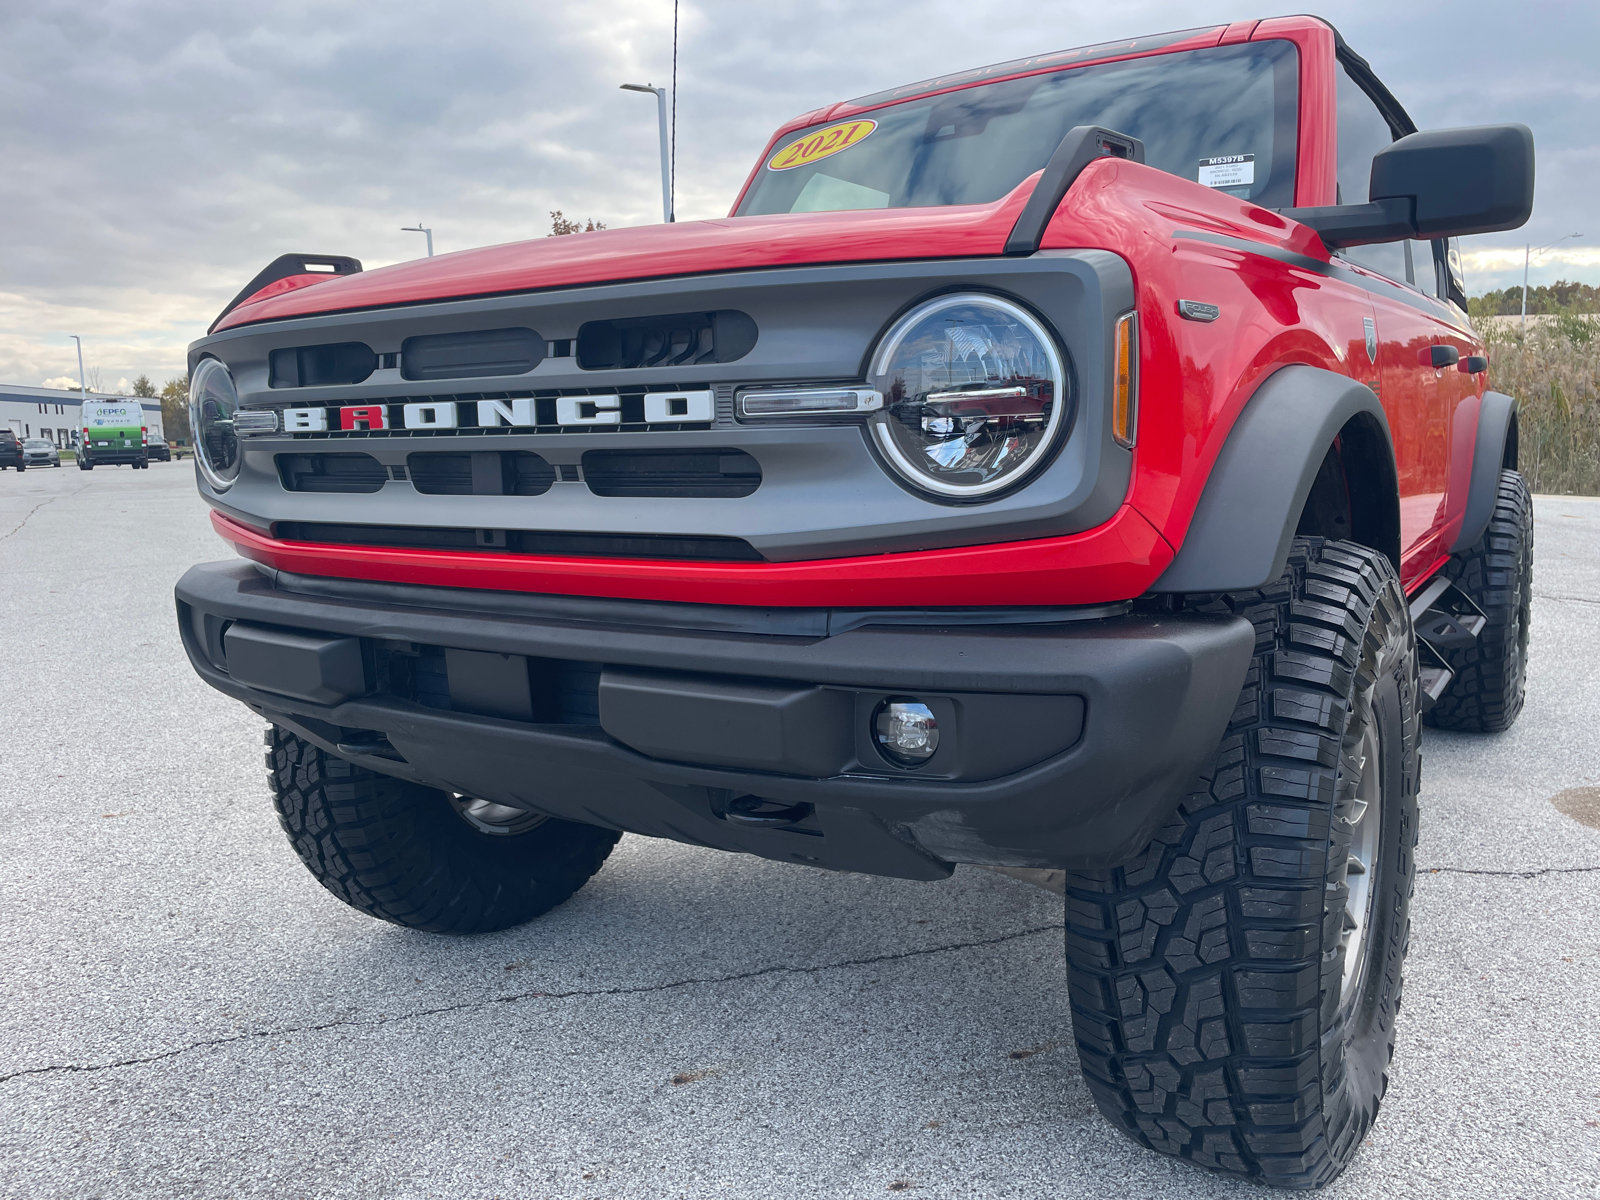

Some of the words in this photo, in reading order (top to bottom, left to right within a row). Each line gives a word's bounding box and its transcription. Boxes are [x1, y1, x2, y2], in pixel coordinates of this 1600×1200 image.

[780, 123, 862, 166] 2021
[1209, 156, 1244, 164] M5397B
[283, 388, 717, 433] BRONCO
